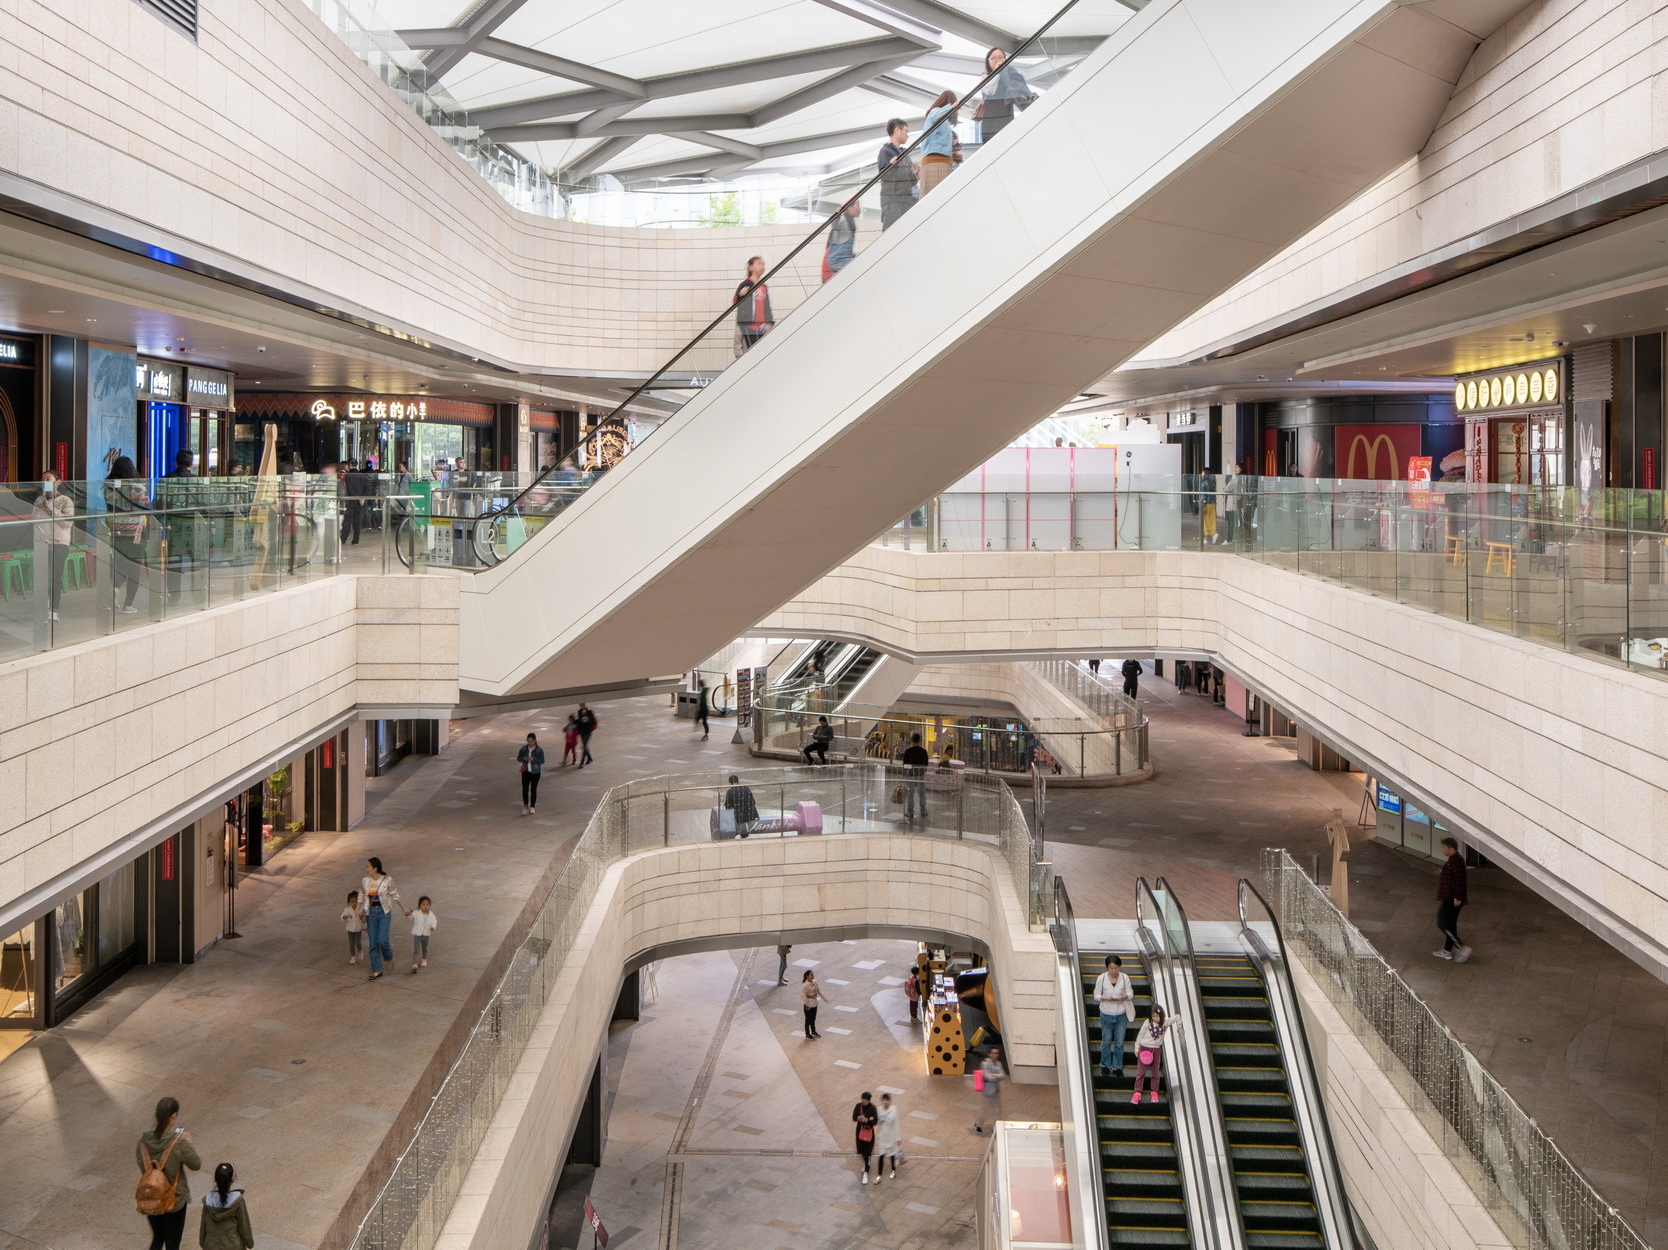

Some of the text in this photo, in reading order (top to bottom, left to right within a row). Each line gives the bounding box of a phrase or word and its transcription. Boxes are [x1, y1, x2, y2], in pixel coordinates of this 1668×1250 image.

[348, 401, 427, 420] 巴依的小羊
[481, 528, 496, 544] L2
